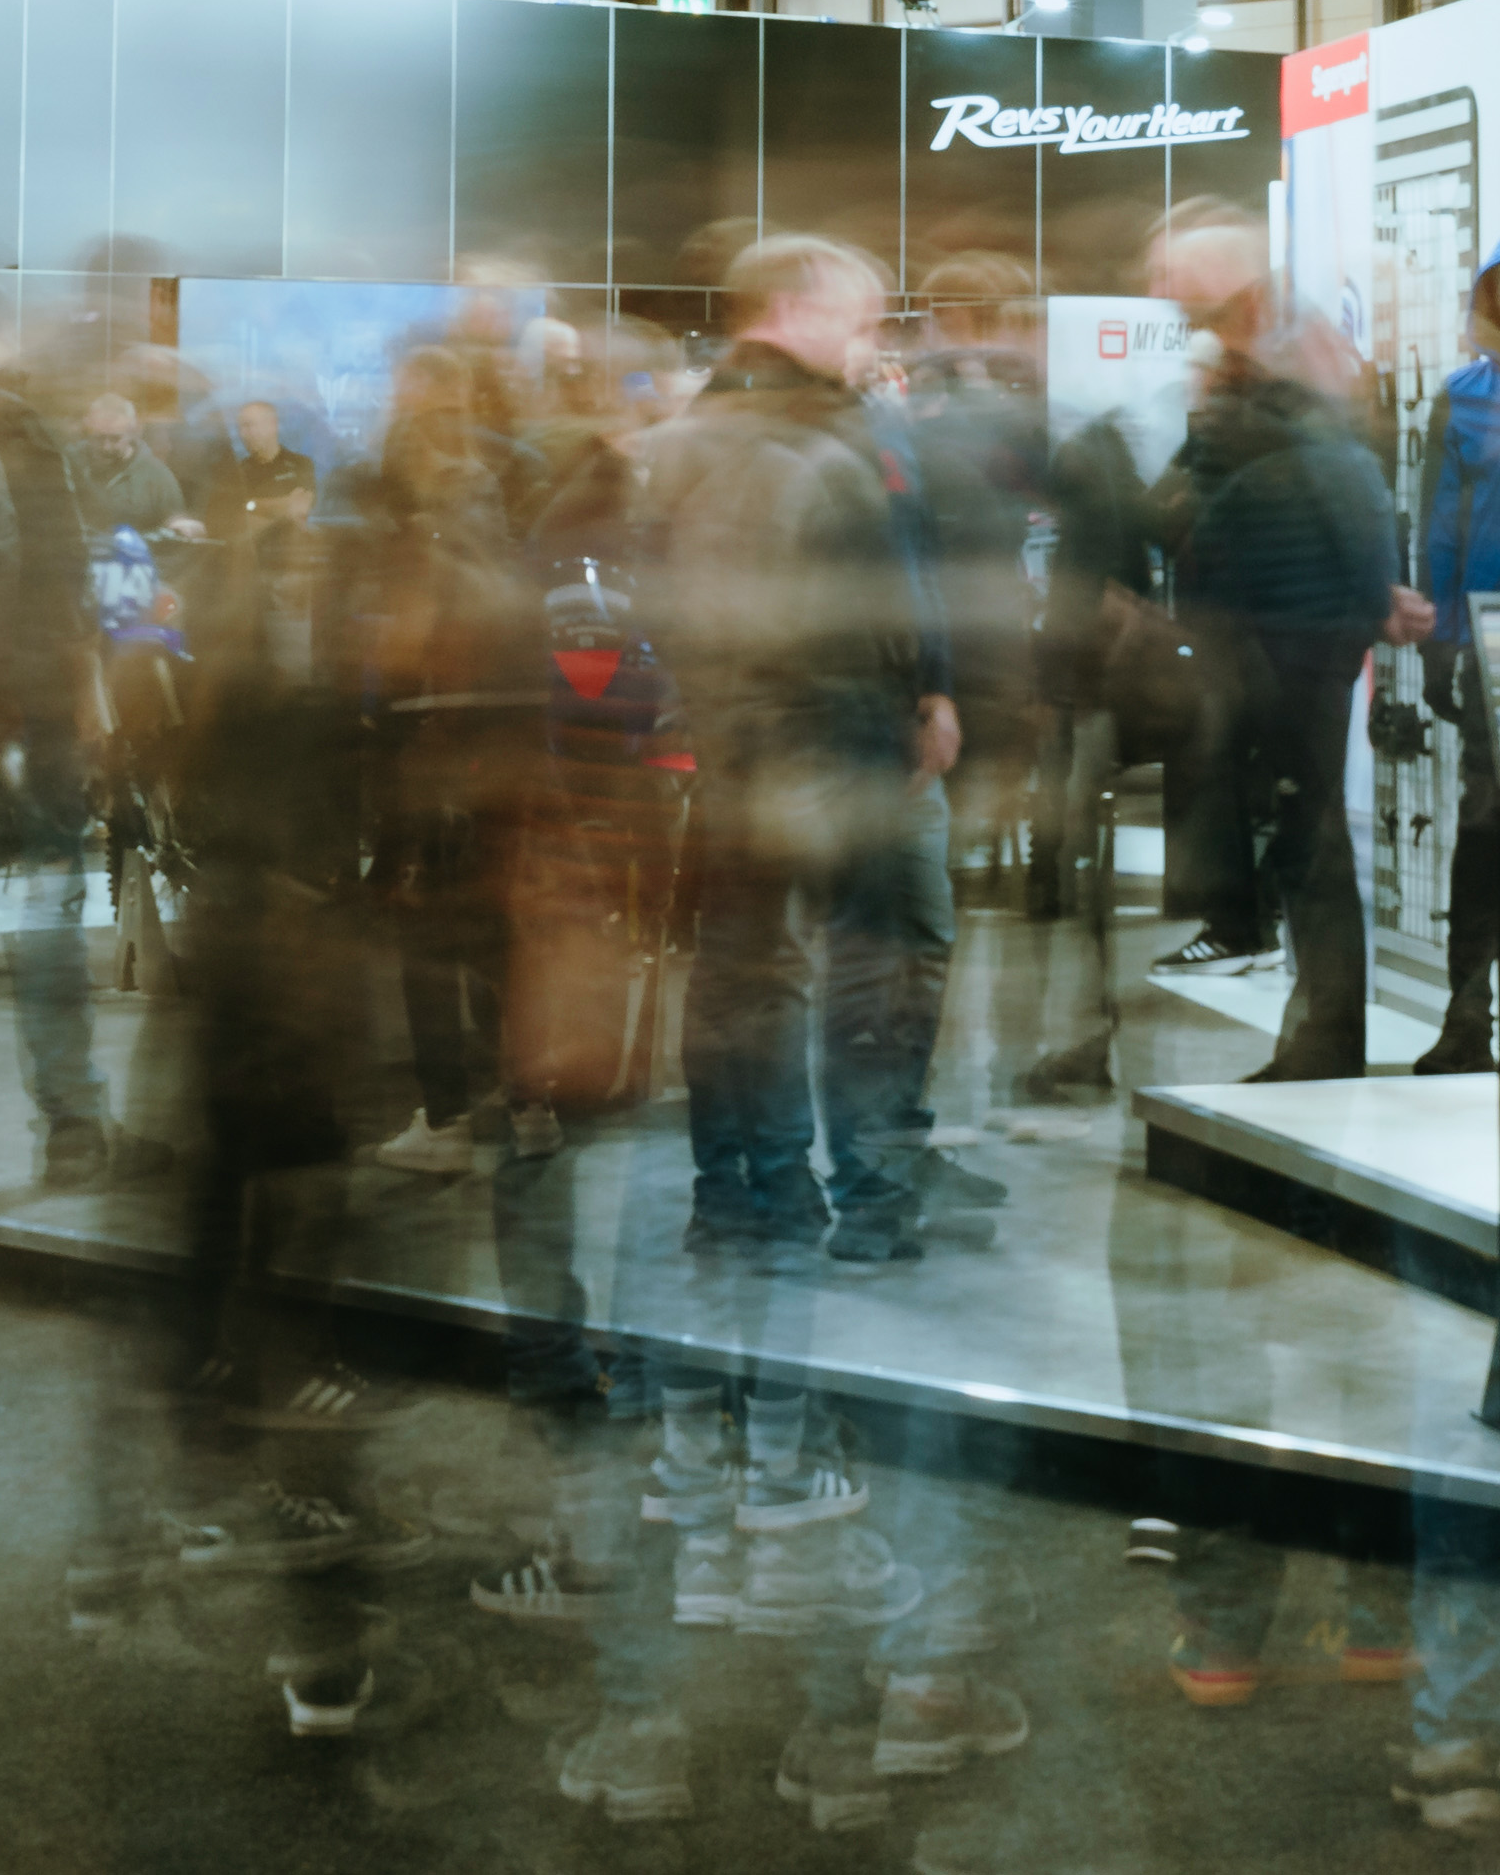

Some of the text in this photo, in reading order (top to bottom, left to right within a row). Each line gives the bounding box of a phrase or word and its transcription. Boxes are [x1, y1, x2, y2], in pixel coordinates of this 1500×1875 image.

[929, 94, 1245, 155] Revs Your Heart
[1132, 322, 1161, 351] MY
